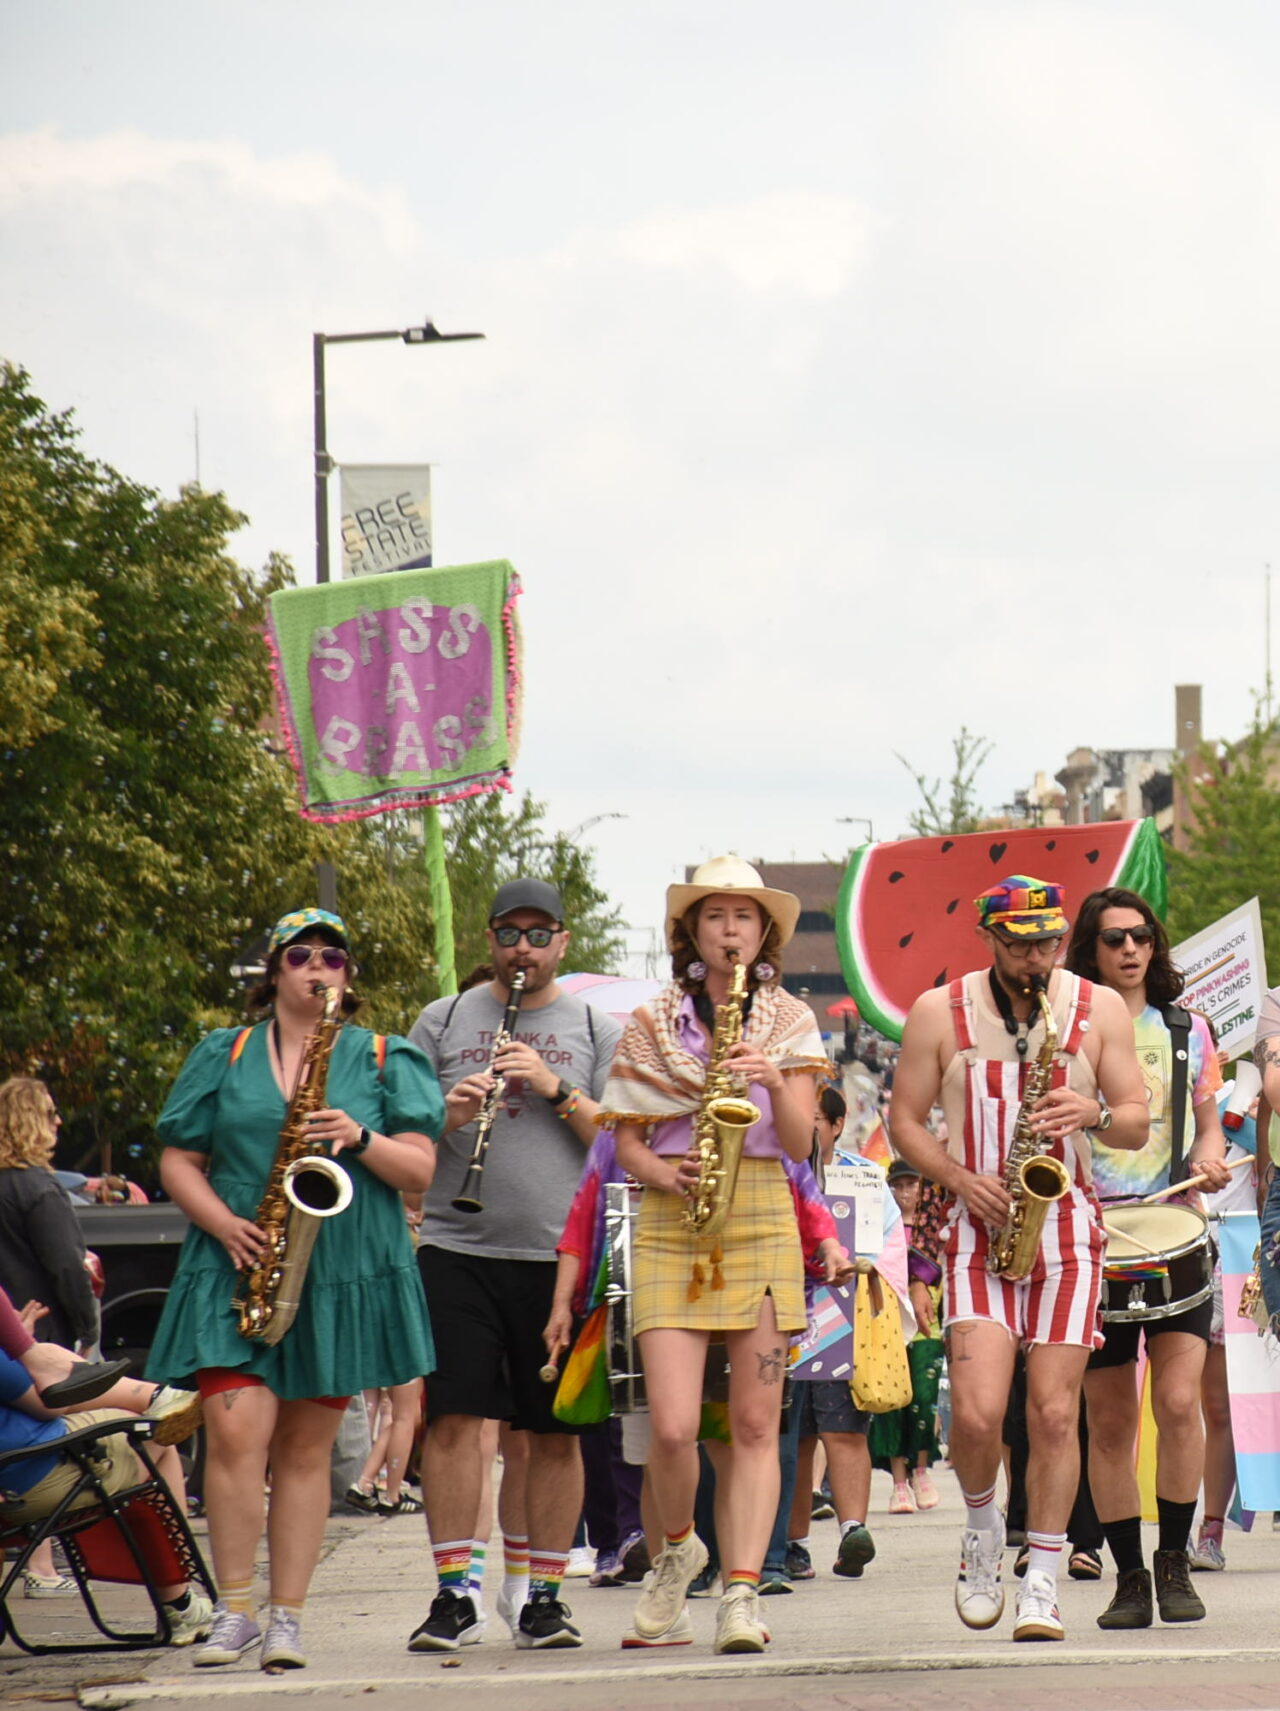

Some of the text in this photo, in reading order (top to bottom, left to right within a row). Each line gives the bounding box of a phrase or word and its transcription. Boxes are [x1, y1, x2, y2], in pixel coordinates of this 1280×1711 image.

[340, 491, 421, 543] FREE
[345, 520, 429, 564] STATE
[351, 539, 431, 577] FESTIVAL
[311, 596, 482, 682] SASS
[313, 695, 498, 785] BRASS
[1186, 931, 1248, 976] RIDE IN GENOCIDE
[1196, 958, 1251, 1000] PINKWASHING
[1217, 973, 1252, 1003] CRIMES
[478, 1030, 558, 1047] THNK A
[1214, 1005, 1256, 1040] LESTINE
